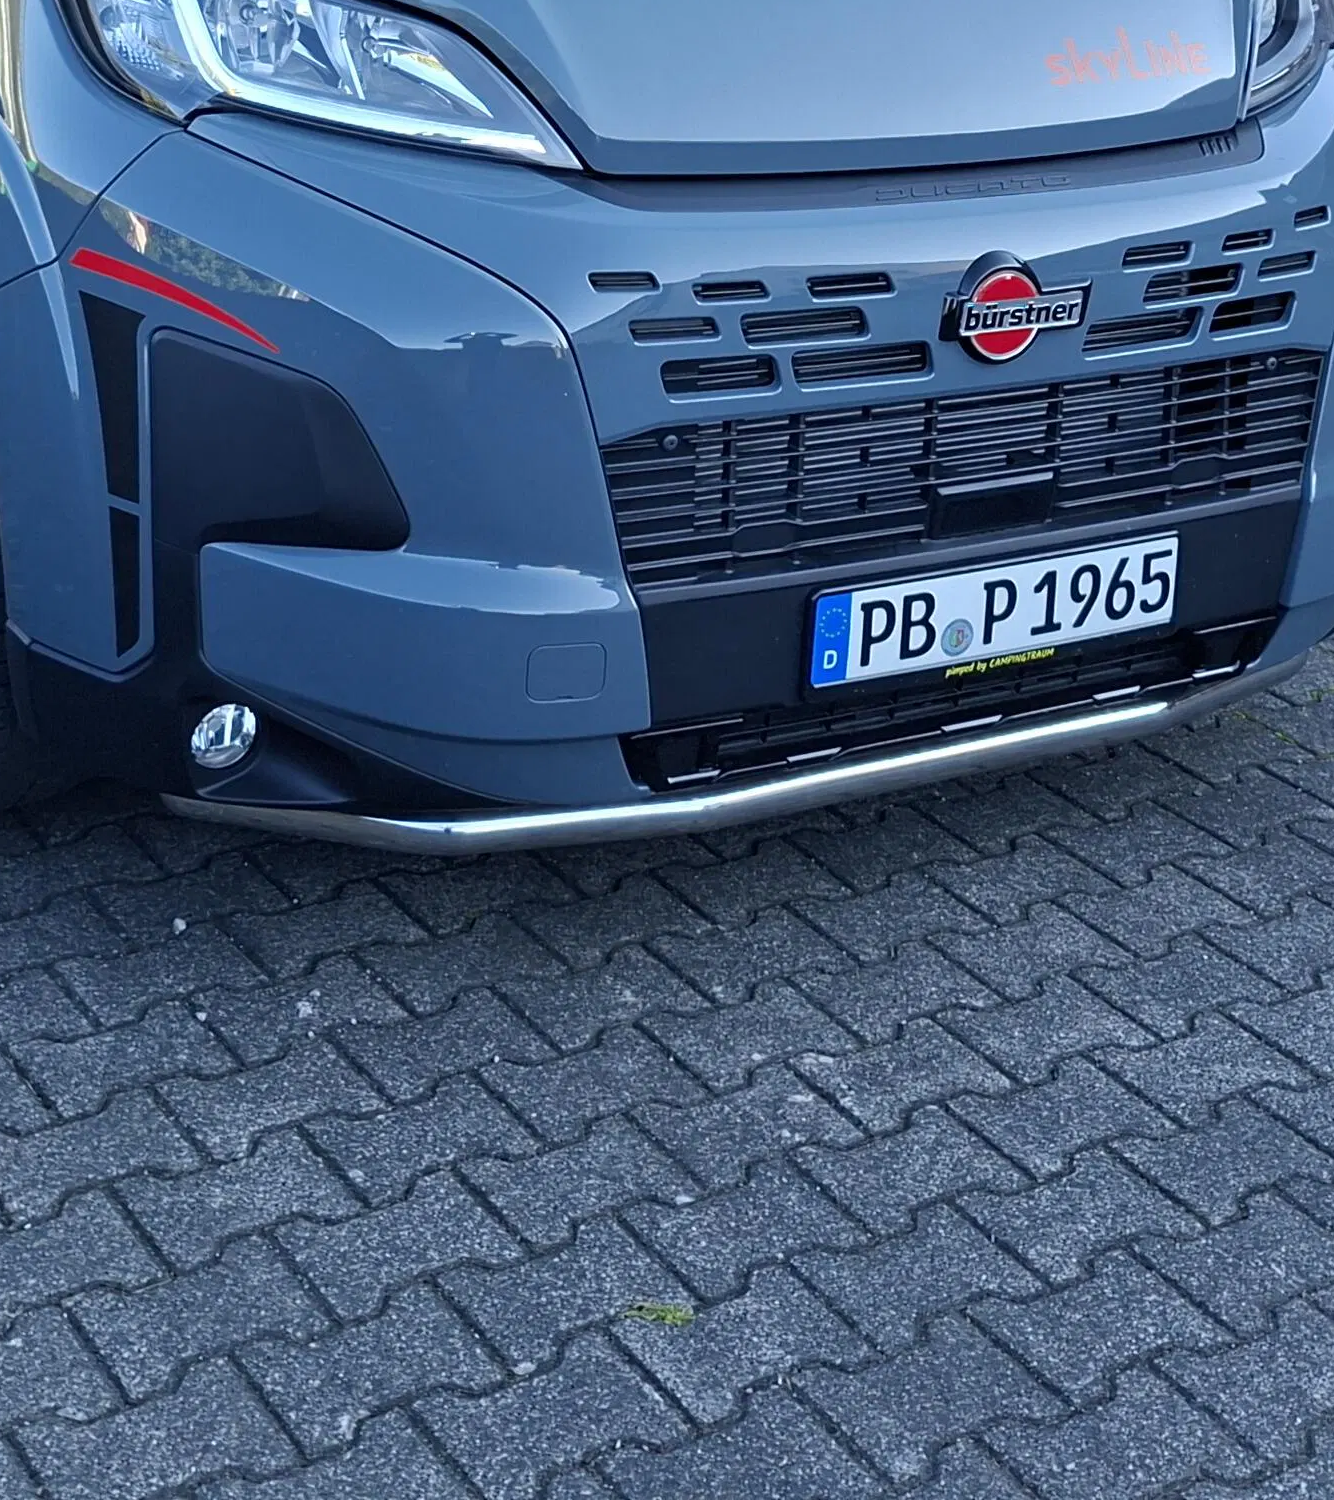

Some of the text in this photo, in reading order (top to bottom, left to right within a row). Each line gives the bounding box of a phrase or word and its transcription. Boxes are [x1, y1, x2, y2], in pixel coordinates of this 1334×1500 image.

[876, 174, 1071, 201] DUCATO
[964, 301, 1080, 332] bürstner
[860, 592, 936, 667] PB
[823, 649, 838, 670] D
[976, 660, 987, 673] by
[989, 647, 1055, 669] CAMPINGTRAUM
